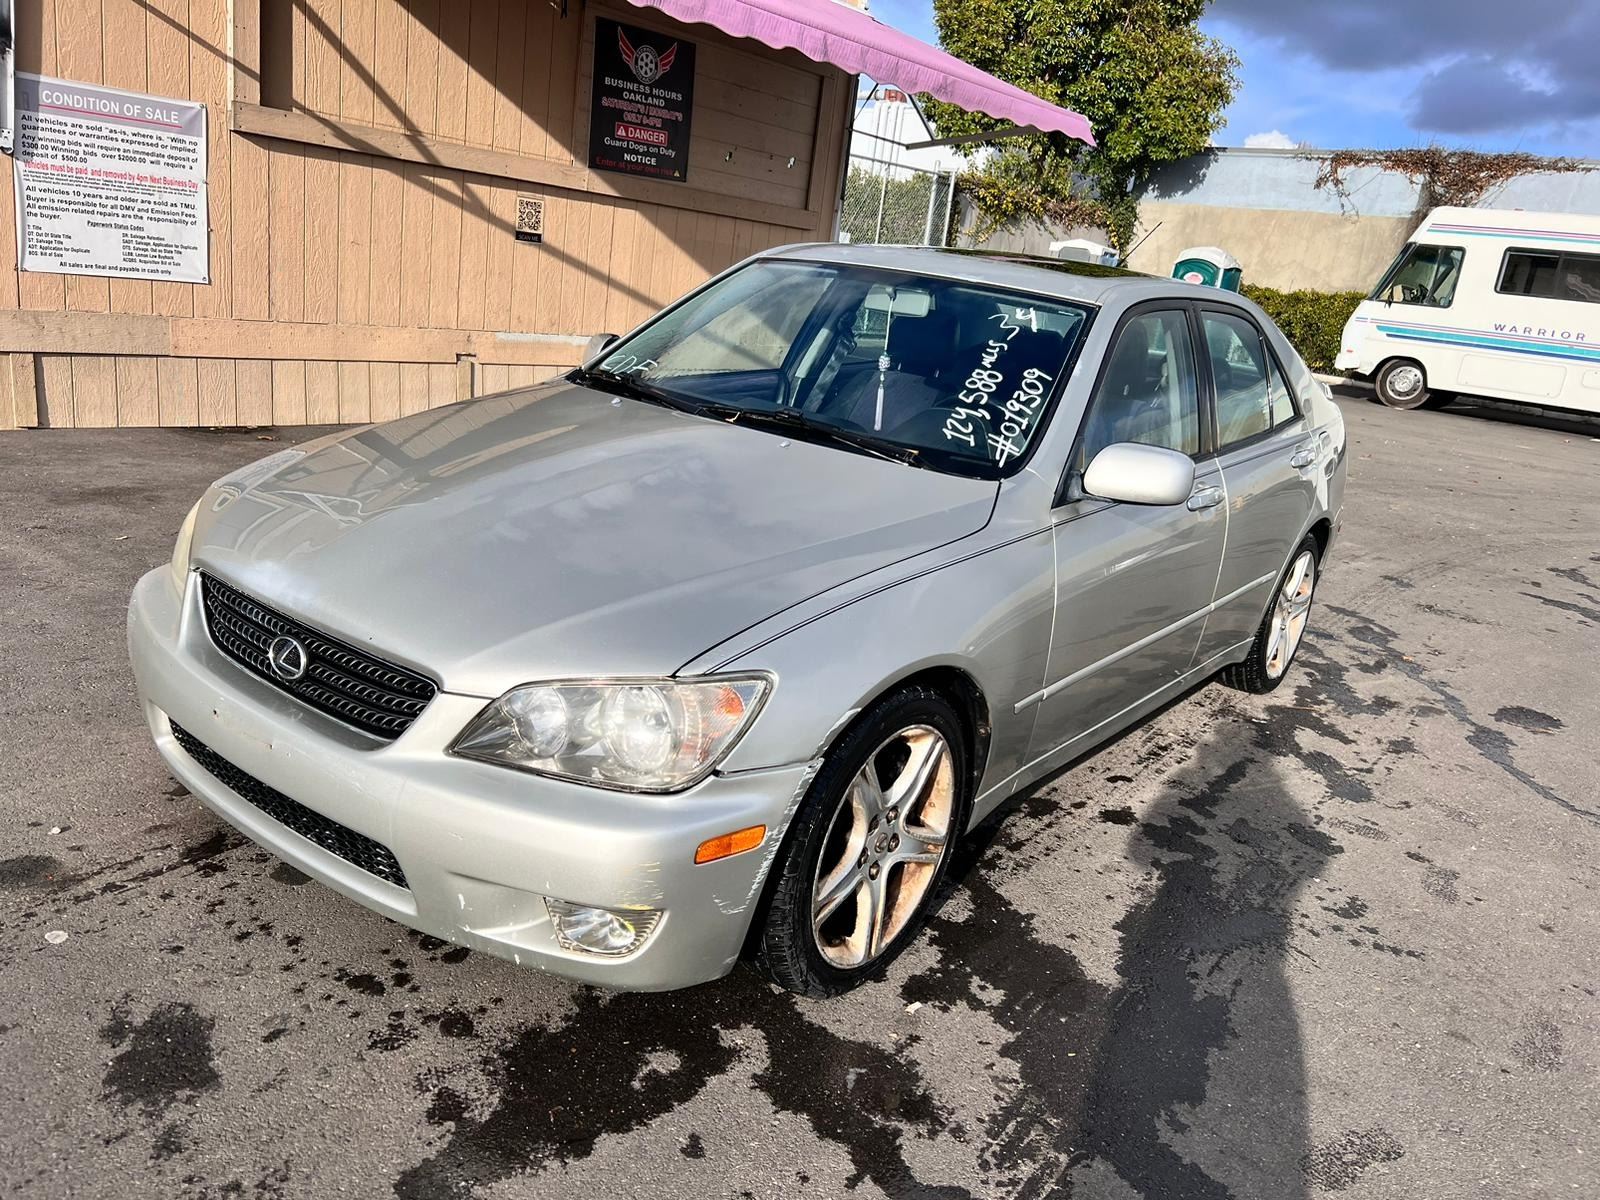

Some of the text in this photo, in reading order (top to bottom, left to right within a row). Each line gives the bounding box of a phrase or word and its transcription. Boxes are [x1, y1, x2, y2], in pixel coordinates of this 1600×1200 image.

[604, 76, 682, 101] BUSINESS HOURS
[623, 91, 665, 107] OAKLAND
[42, 91, 179, 123] CONDITION OF SALE
[21, 114, 32, 122] All
[35, 117, 68, 127] vehicles
[86, 124, 103, 132] sold
[131, 131, 153, 140] where
[628, 127, 665, 143] DANGER
[21, 123, 66, 135] guarantees
[79, 131, 118, 142] warranties
[121, 138, 158, 148] expressed
[170, 144, 197, 154] implied.
[21, 133, 36, 142] Any
[38, 135, 65, 146] winning
[67, 139, 82, 147] bids
[84, 141, 95, 149] will
[97, 144, 121, 153] require
[132, 149, 165, 159] immediate
[167, 153, 190, 163] deposit
[604, 136, 627, 148] Guard
[629, 141, 647, 152] Dogs
[659, 147, 676, 158] Duty
[21, 141, 48, 151] $300.00
[50, 145, 79, 155] Winning
[83, 149, 97, 157] bids
[118, 154, 146, 164] $2000.00
[164, 161, 185, 169] require
[22, 149, 48, 159] deposit
[61, 154, 87, 163] $500.00
[596, 156, 616, 166] Enter
[623, 153, 657, 165] NOTICE
[24, 160, 198, 190] Vehicles must be paid and removed by 4pm Next Business Day
[26, 194, 47, 203] Buyer
[57, 199, 97, 208] responsible
[119, 204, 135, 212] DMV
[151, 208, 179, 217] Emission
[38, 187, 70, 196] vehicles
[82, 192, 103, 200] years
[120, 195, 138, 203] older
[180, 202, 197, 210] TMU.
[38, 204, 69, 213] emission
[147, 215, 188, 226] responsibility
[39, 212, 62, 220] buyer.
[87, 220, 112, 229] Paperwork
[113, 222, 129, 230] Status
[1494, 323, 1586, 341] WARRIOR
[987, 367, 1053, 468] #019309
